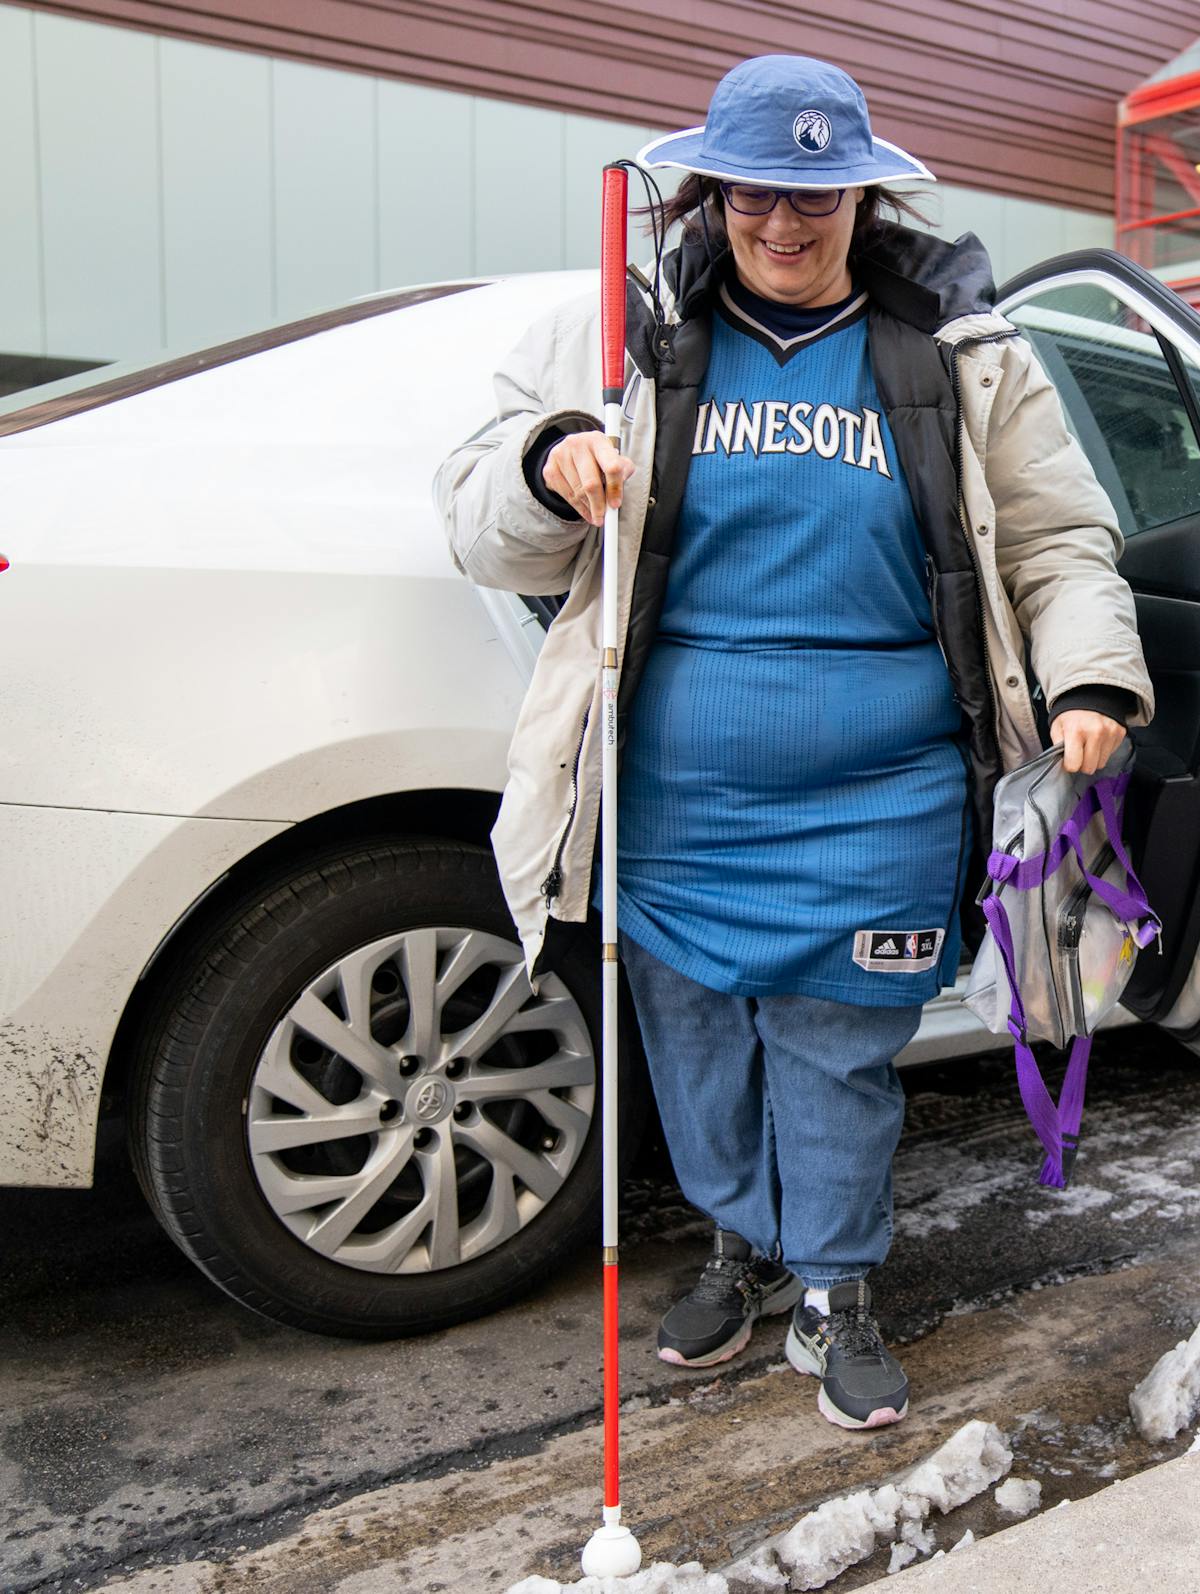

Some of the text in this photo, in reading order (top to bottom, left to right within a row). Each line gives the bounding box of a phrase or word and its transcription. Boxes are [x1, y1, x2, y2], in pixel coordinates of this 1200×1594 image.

[691, 397, 893, 481] INNESOTA
[607, 703, 615, 746] ambutech
[920, 942, 933, 952] 3XL
